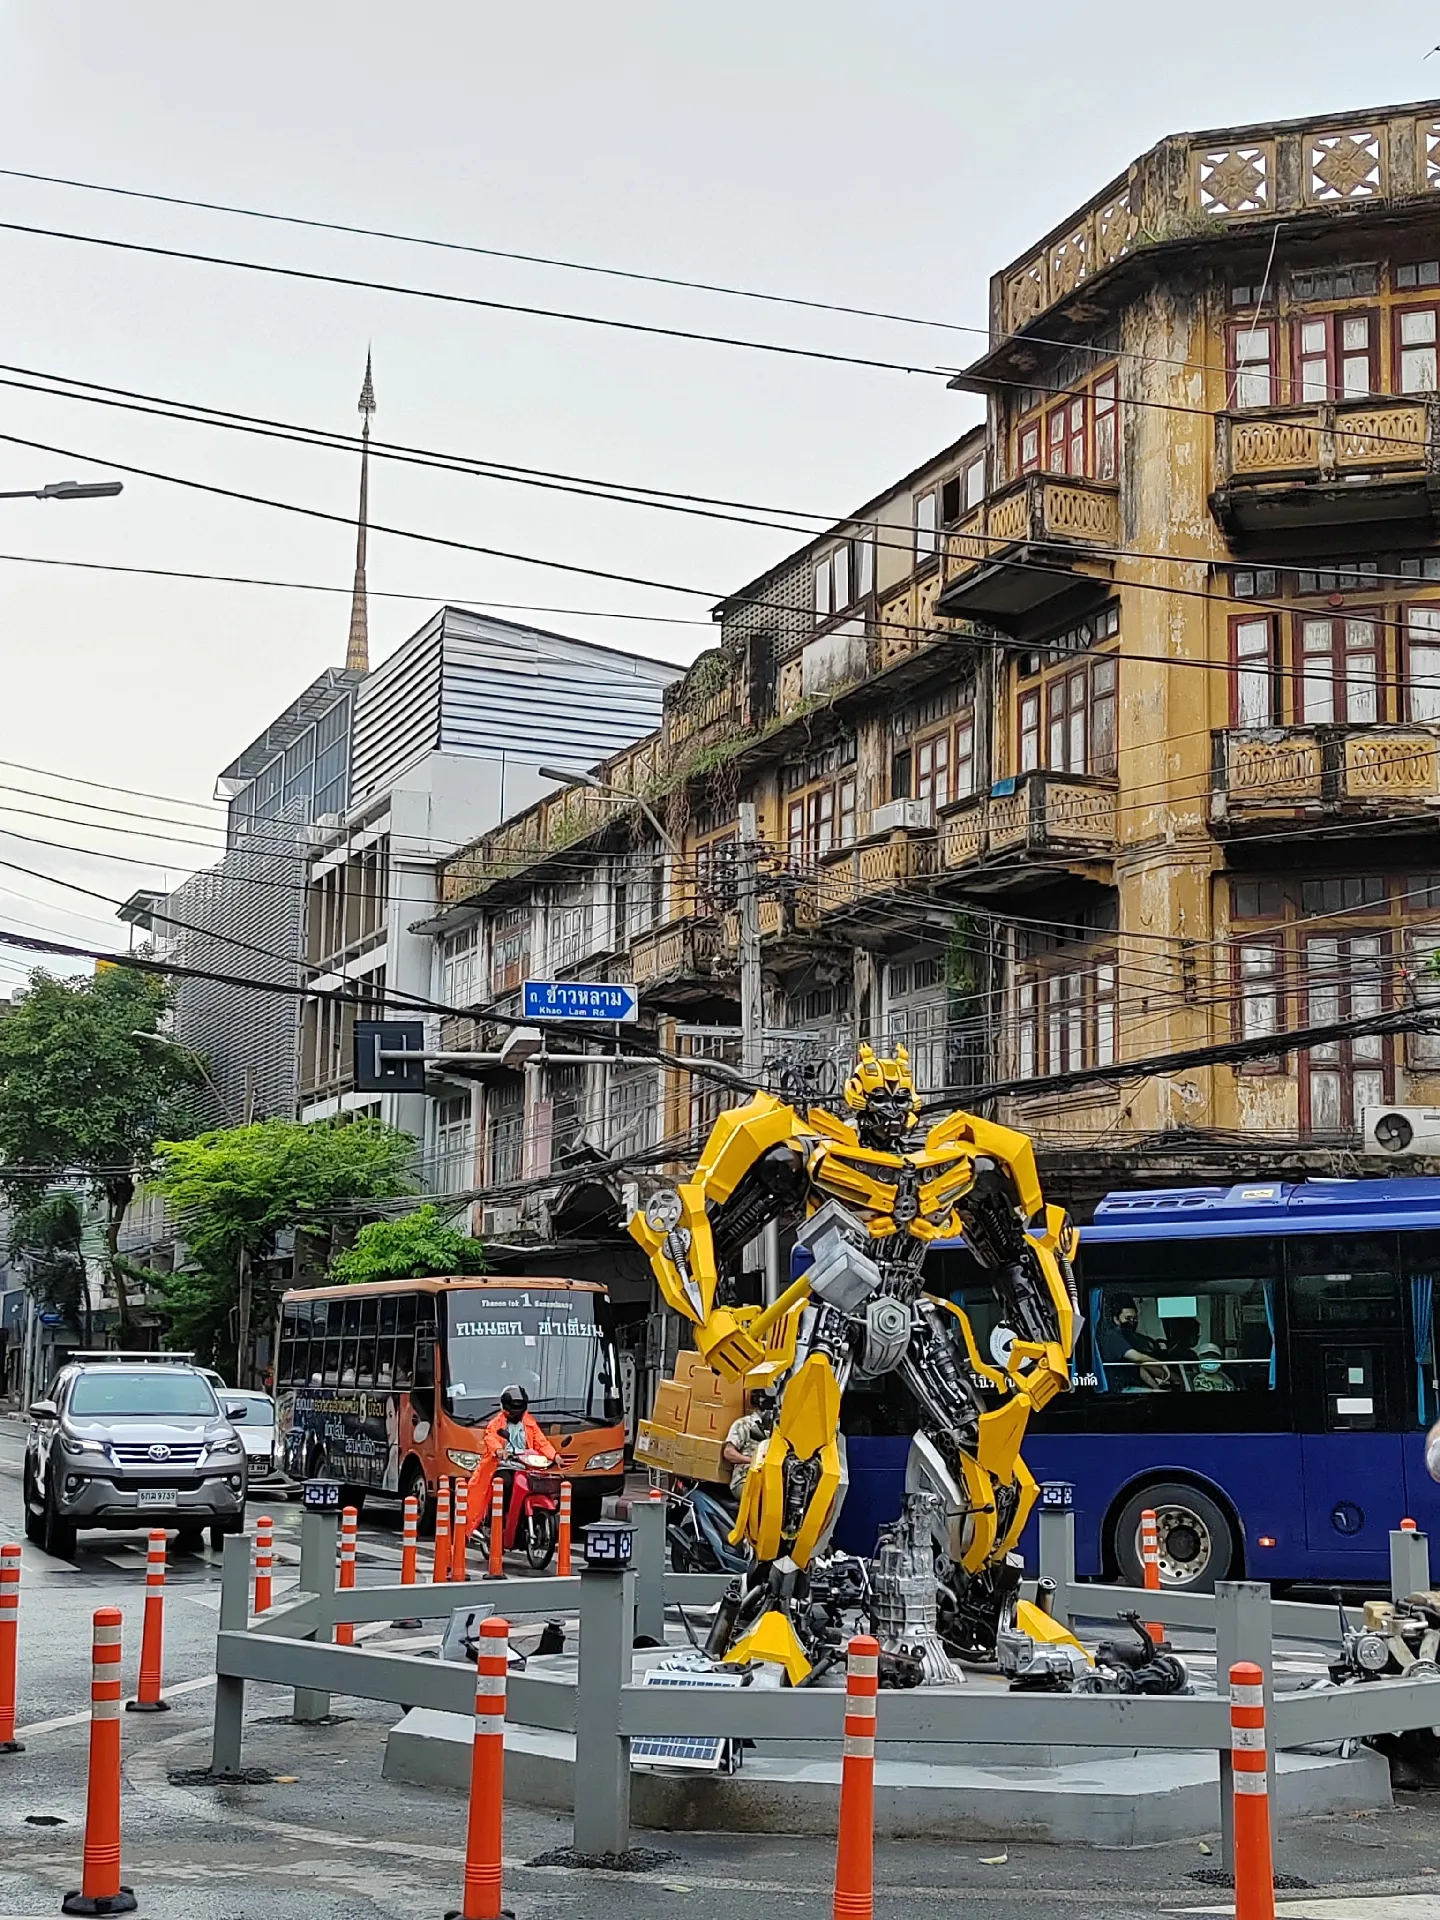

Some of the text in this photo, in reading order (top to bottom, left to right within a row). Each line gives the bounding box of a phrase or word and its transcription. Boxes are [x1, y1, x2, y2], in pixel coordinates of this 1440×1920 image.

[546, 985, 622, 1006] ข้าวหลาม
[539, 1006, 607, 1017] Khao Lam Rd.
[520, 1292, 533, 1307] 1
[456, 1316, 604, 1338] ถนนตก ท่าเตียน
